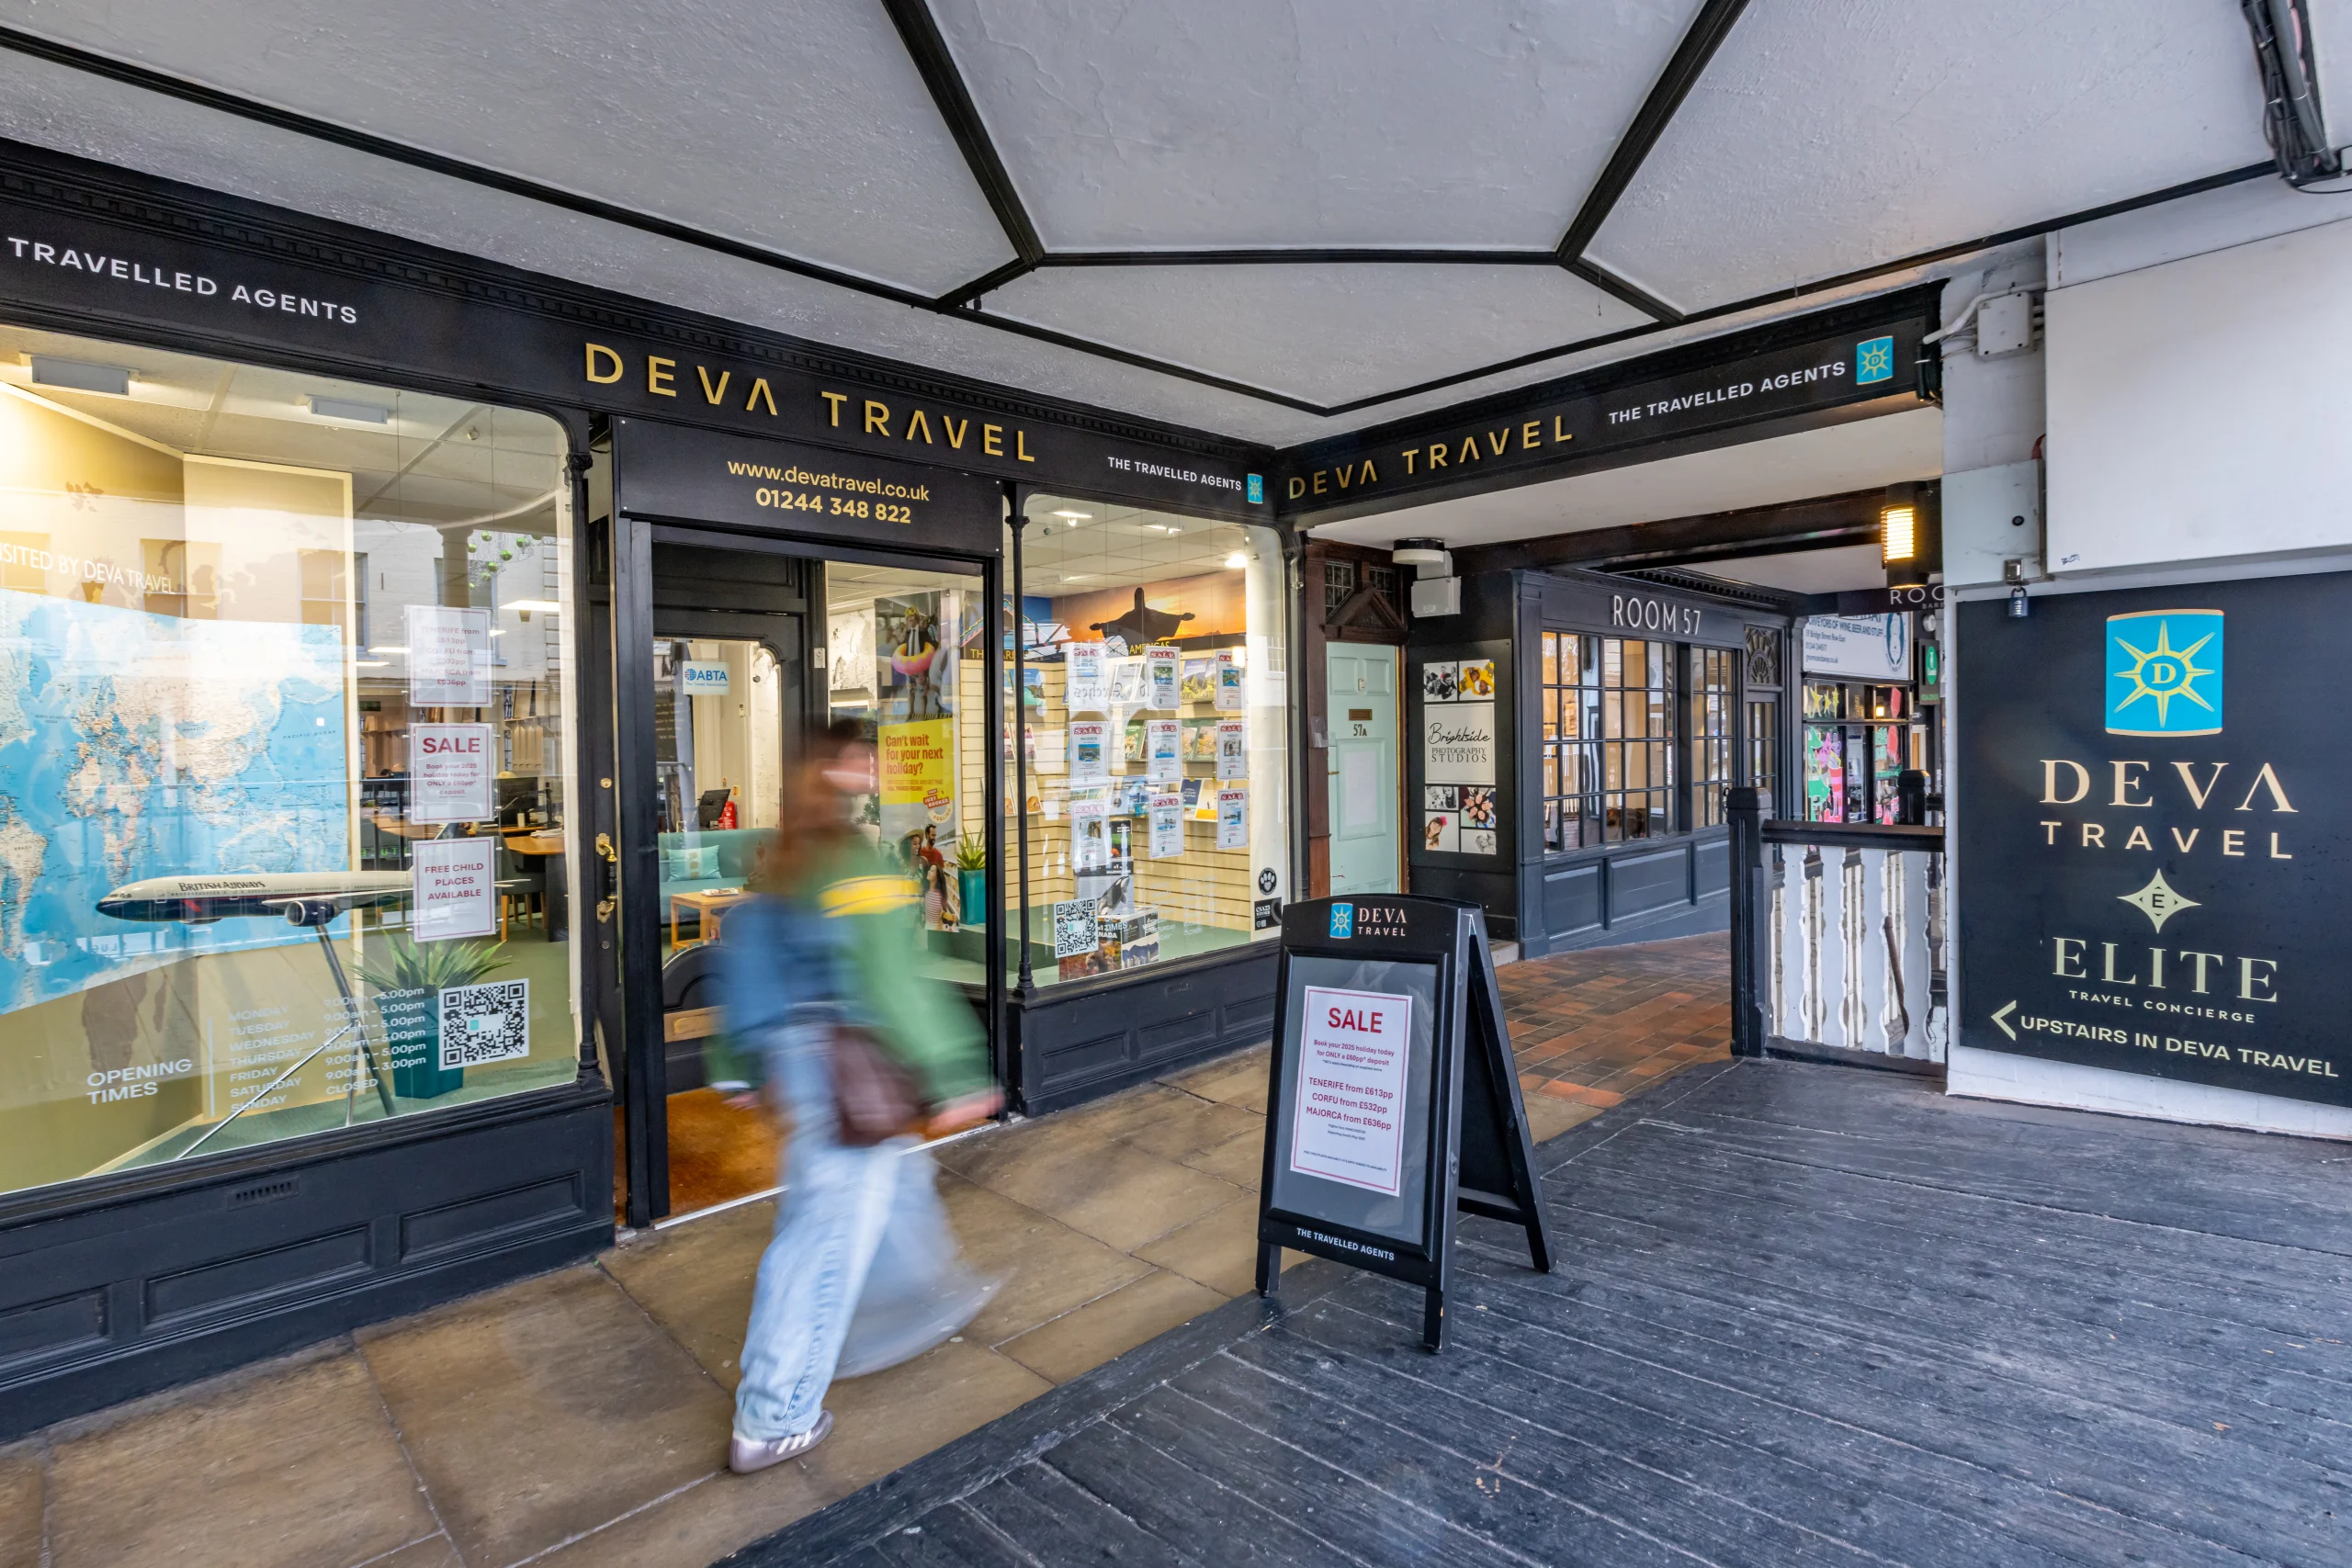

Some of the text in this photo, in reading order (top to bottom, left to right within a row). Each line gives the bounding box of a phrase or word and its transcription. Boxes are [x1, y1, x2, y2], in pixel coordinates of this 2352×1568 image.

[7, 237, 357, 324] TRAVELLED AGENTS
[1609, 361, 1846, 424] THE TRAVELLED AGENTS
[585, 343, 1035, 462] DEVA TRAVEL
[1289, 415, 1573, 500] DEVA TRAVEL
[727, 460, 930, 502] www.devatravel.co.uk
[1108, 457, 1242, 491] THE TRAVELLED AGENTS
[755, 488, 911, 524] 01244 348 822
[59, 554, 80, 576] BY
[84, 560, 124, 585] DEVA
[126, 569, 176, 595] TRAVEL
[1613, 594, 1701, 635] ROOM 57
[1149, 650, 1175, 659] SALE
[696, 671, 728, 681] ABTA
[2151, 662, 2177, 684] D
[1074, 727, 1102, 735] SALE
[1151, 724, 1177, 732] SALE
[1352, 724, 1367, 737] 57A
[1428, 722, 1491, 745] Brightside
[423, 737, 481, 754] SALE
[886, 734, 930, 747] Can't wait
[886, 747, 944, 761] for your next
[1431, 754, 1487, 763] STUDIOS
[887, 762, 923, 775] holiday?
[2039, 760, 2299, 813] DEVA
[928, 798, 949, 807] BOOKED
[1220, 793, 1244, 801] SALE
[2041, 821, 2292, 860] TRAVEL
[424, 863, 484, 874] FREE CHILD
[178, 882, 221, 892] BRITISH
[435, 876, 474, 886] PLACES
[427, 889, 481, 900] AVAILABLE
[2151, 893, 2165, 909] E
[1358, 908, 1407, 923] DEVA
[1357, 926, 1406, 937] TRAVEL
[2052, 936, 2278, 1003] ELITE
[380, 987, 425, 1000] 5.00pm
[380, 1001, 425, 1015] 5.00pm
[2069, 989, 2256, 1024] TRAVEL CONCIERGE
[228, 1020, 291, 1037] TUESDAY
[380, 1015, 425, 1029] 5.00pm
[1328, 1007, 1383, 1034] SALE
[229, 1030, 316, 1052] WEDNESDAY
[380, 1029, 426, 1043] 5.00pm
[381, 1043, 426, 1057] 5.00pm
[1341, 1043, 1355, 1051] 2025
[1356, 1044, 1376, 1055] holiday
[1378, 1048, 1396, 1057] today
[2021, 1014, 2339, 1078] UPSTAIRS IN DEVA TRAVEL
[230, 1047, 303, 1067] THURSDAY
[381, 1057, 427, 1072] 3.00pm
[1325, 1050, 1341, 1059] ONLY
[1367, 1057, 1390, 1066] deposit
[86, 1058, 193, 1087] OPENING
[230, 1066, 278, 1083] FRIDAY
[86, 1081, 159, 1105] TIMES
[230, 1077, 302, 1098] SATURDAY
[326, 1078, 379, 1096] CLOSED
[1309, 1077, 1394, 1100] TENERIFE from £613pp
[1312, 1092, 1387, 1114] CORFU from £532pp
[1306, 1106, 1392, 1130] MAJORCA from £636pp
[1296, 1227, 1395, 1261] THE TRAVELLED AGENTS
